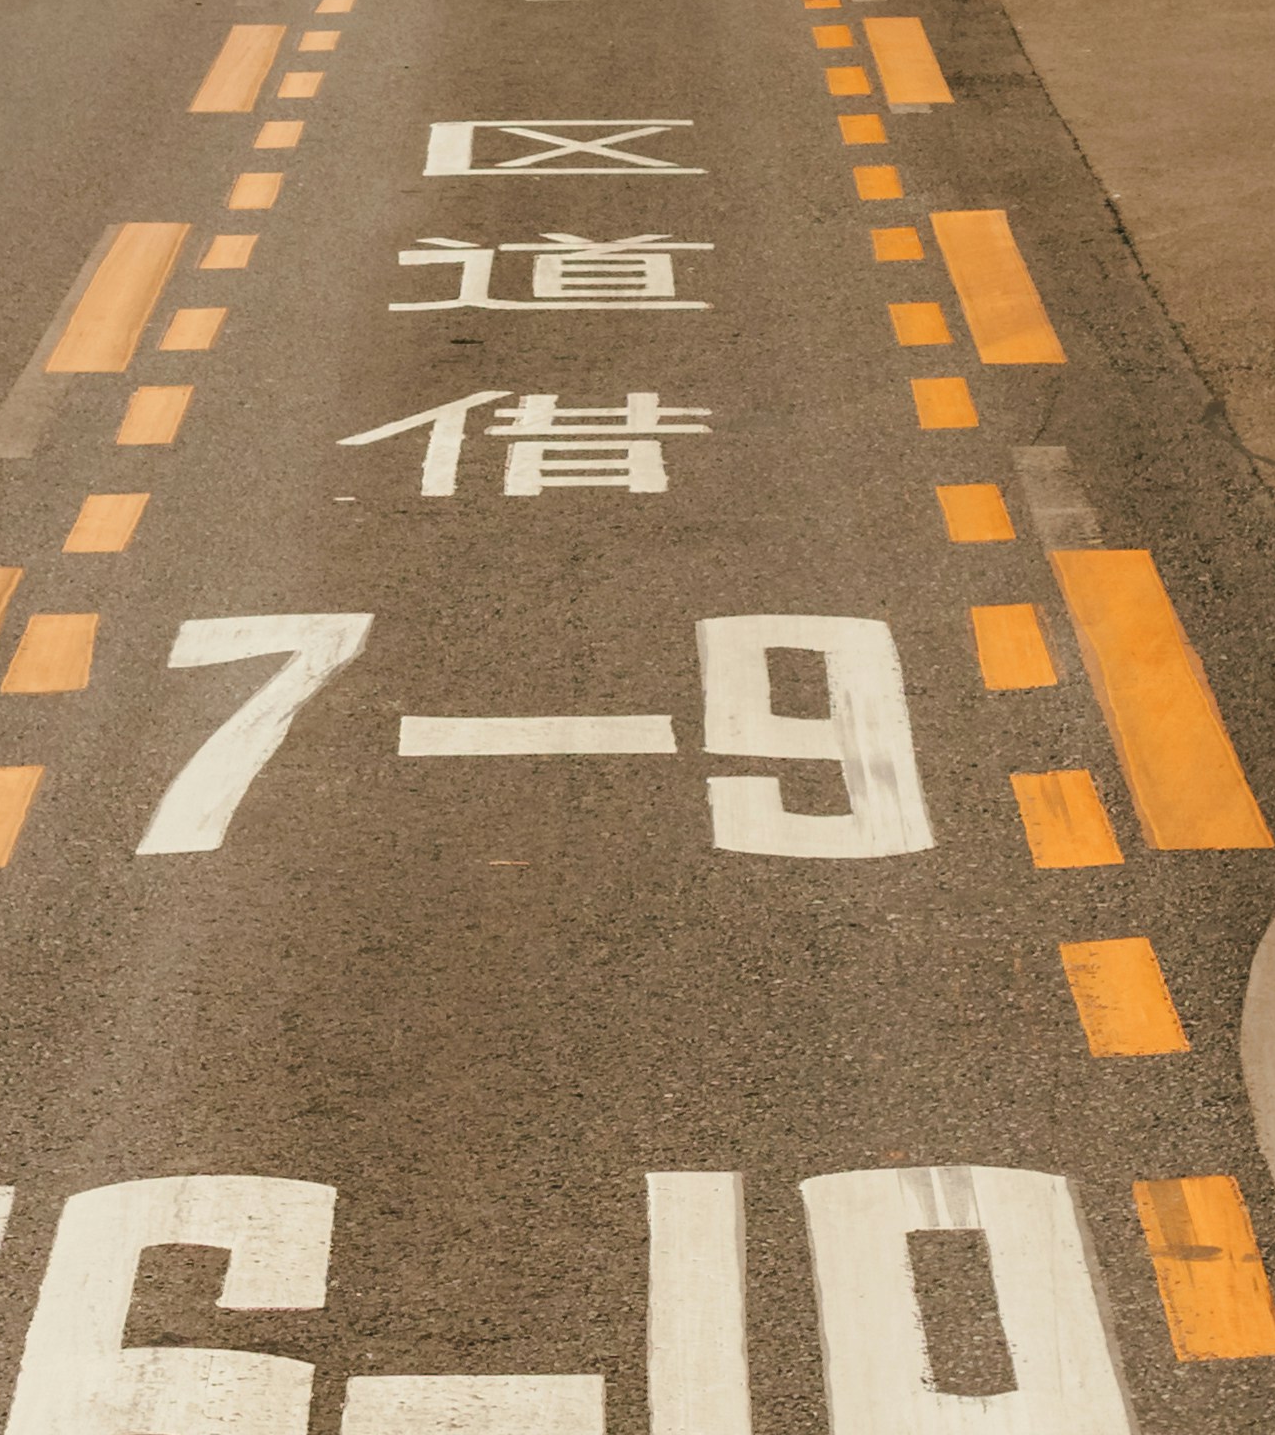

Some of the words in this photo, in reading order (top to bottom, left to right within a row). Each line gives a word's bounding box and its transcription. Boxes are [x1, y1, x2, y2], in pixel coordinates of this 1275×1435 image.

[423, 120, 709, 176] 区
[388, 232, 715, 311] 道
[336, 390, 714, 497] 借
